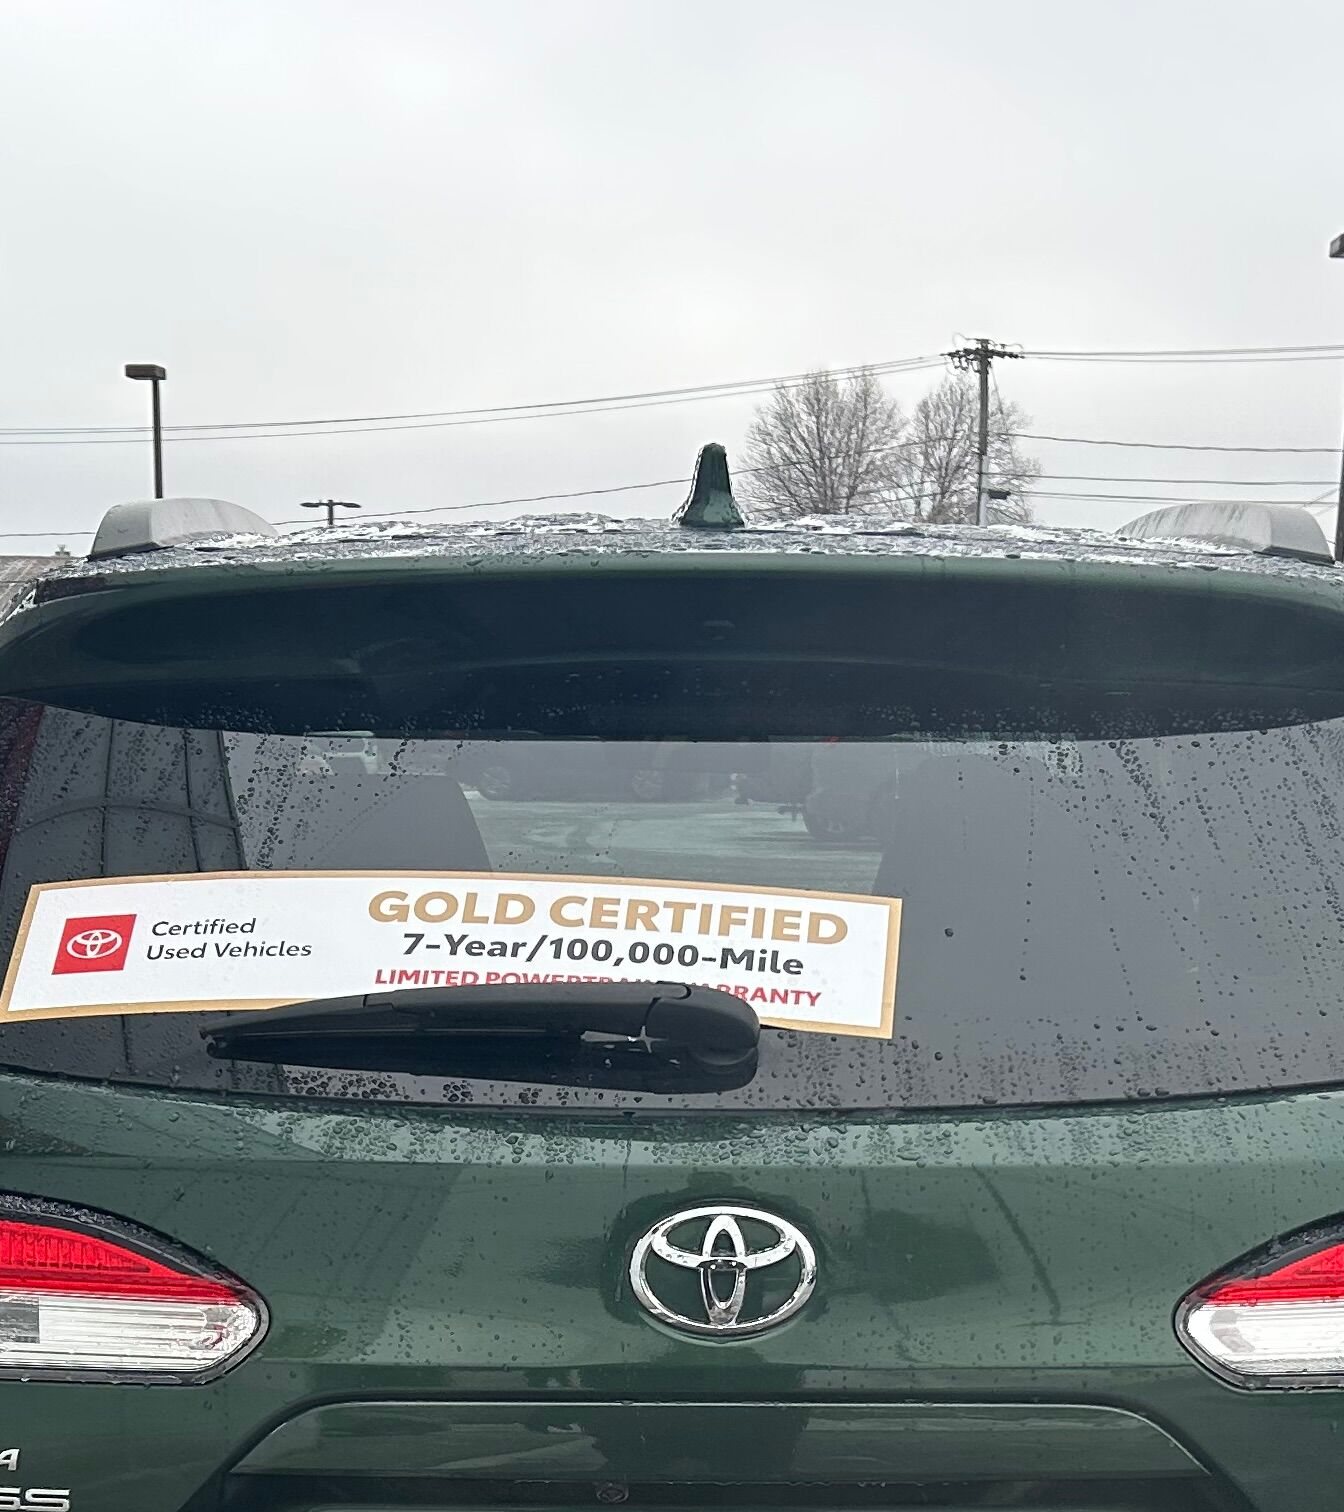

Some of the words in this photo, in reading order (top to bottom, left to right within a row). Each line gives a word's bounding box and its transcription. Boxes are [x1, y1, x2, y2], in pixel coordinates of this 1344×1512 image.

[150, 917, 257, 937] Certified
[367, 890, 536, 924] GOLD
[549, 895, 849, 945] CERTIFIED
[146, 942, 207, 961] Used
[214, 940, 313, 959] Vehicles
[402, 932, 805, 976] 7-Year/100,000-Mile
[374, 968, 479, 986] LIMITED
